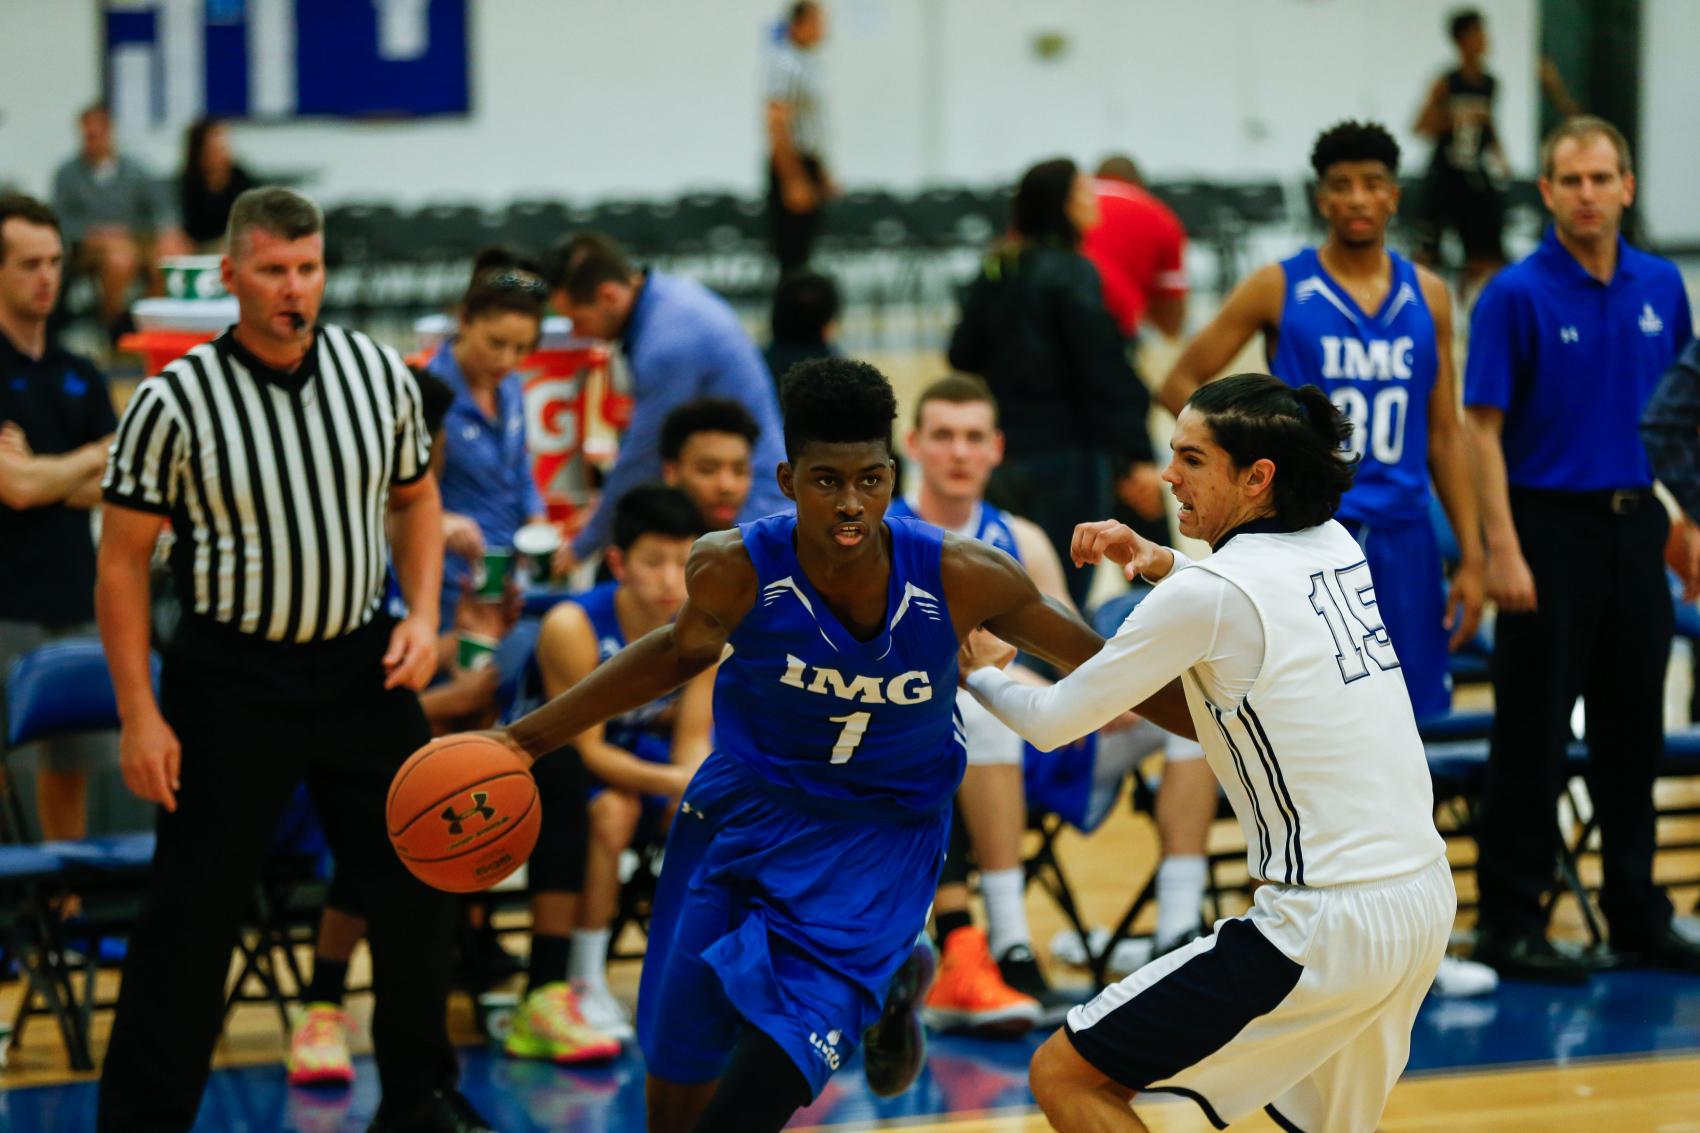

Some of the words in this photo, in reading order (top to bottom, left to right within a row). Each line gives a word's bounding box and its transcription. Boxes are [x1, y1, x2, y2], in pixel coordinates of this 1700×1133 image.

[1320, 335, 1413, 381] IMG
[525, 379, 578, 452] G
[1330, 386, 1408, 465] 30
[1308, 559, 1401, 685] 15
[779, 653, 933, 705] IMG
[829, 711, 871, 765] 1
